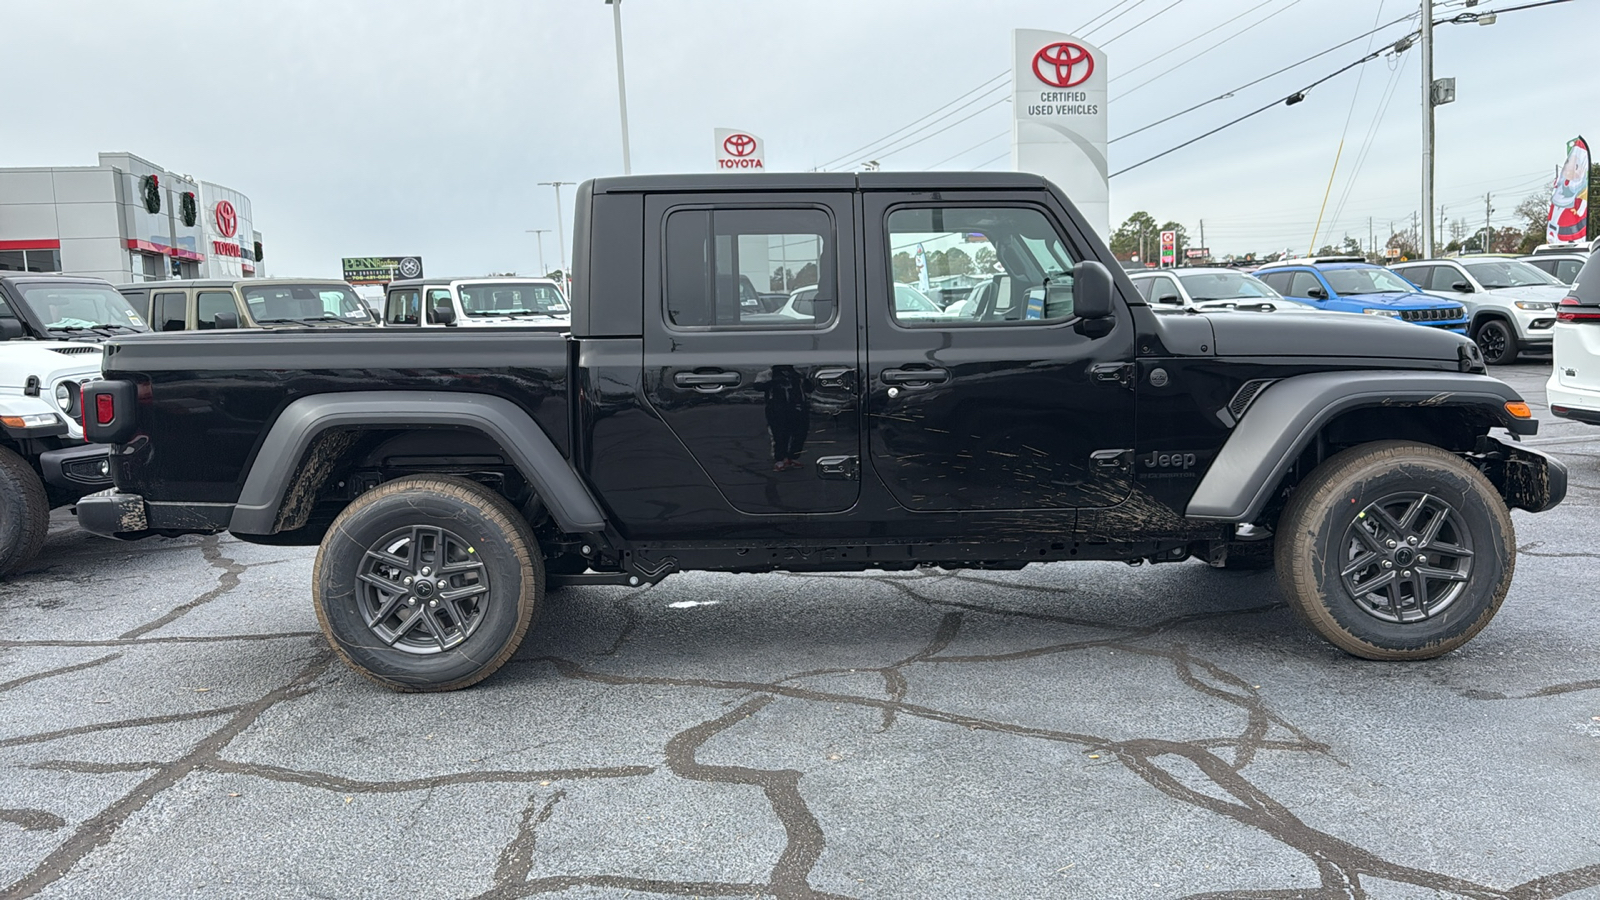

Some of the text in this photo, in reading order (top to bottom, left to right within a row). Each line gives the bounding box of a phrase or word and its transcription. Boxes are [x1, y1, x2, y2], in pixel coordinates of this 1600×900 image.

[1040, 92, 1086, 102] CERTIFIED
[1028, 104, 1098, 116] USED VEHICLES
[718, 159, 763, 169] TOYOTA
[344, 258, 377, 269] PENN
[1145, 450, 1197, 470] Jeep
